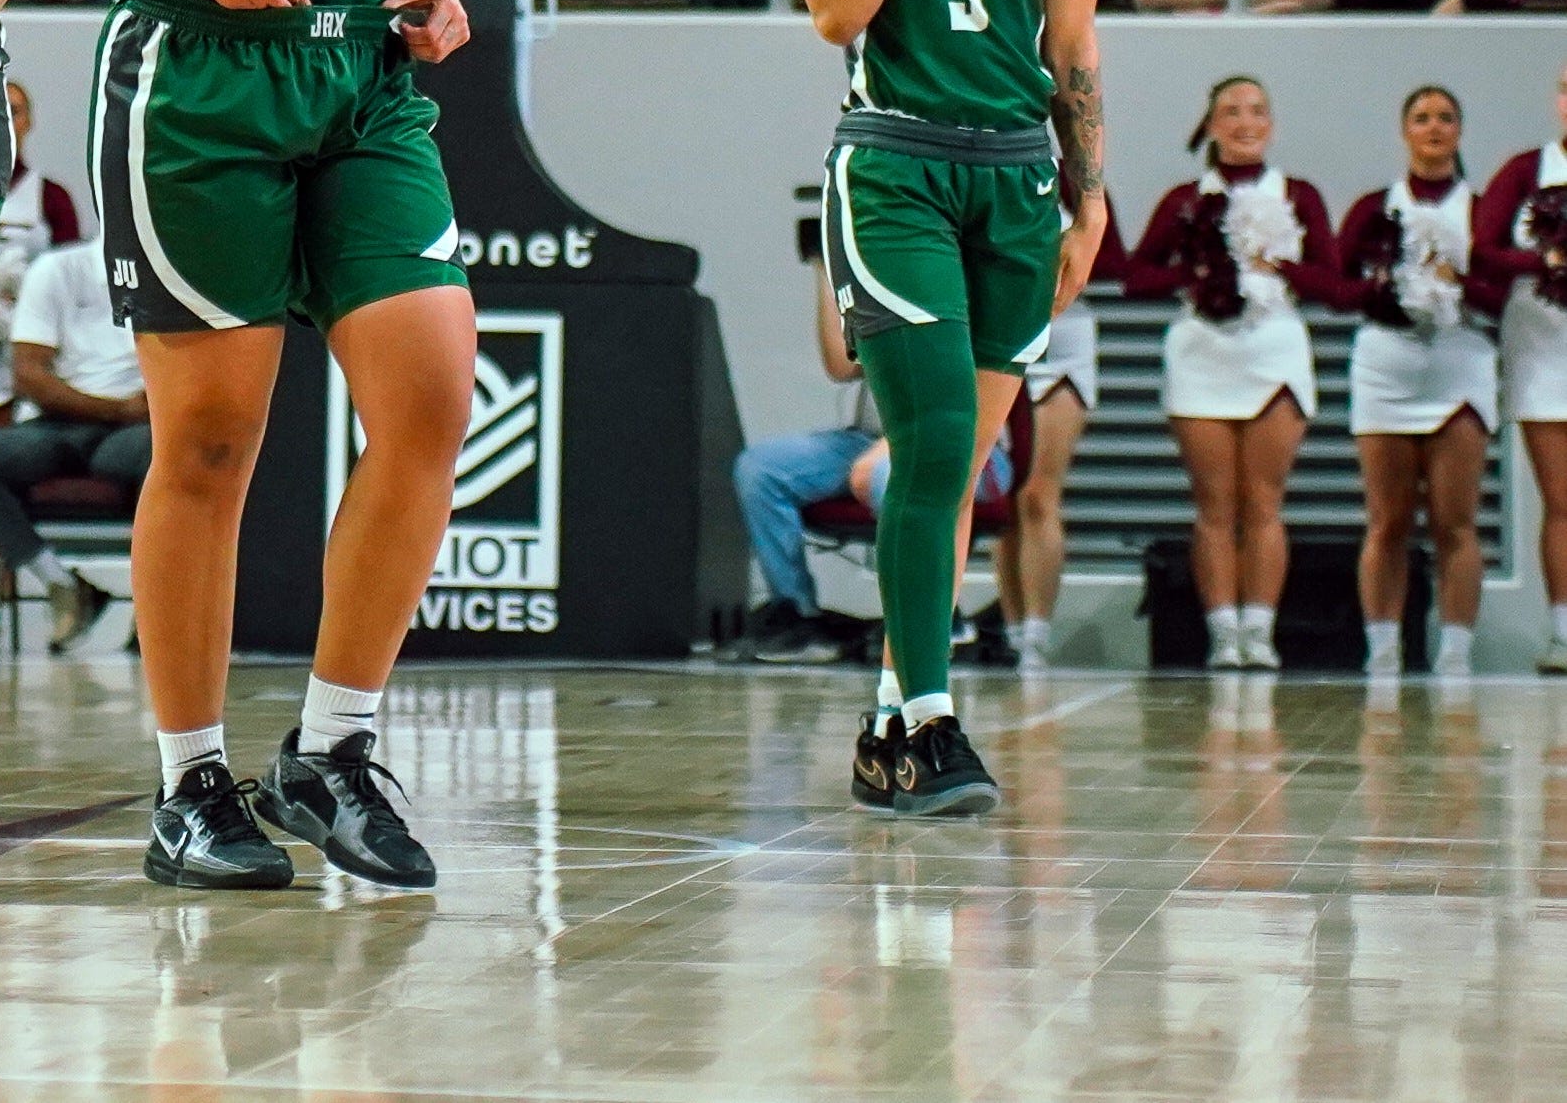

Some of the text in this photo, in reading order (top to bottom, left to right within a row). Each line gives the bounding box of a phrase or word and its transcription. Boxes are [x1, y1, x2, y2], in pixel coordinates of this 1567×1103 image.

[310, 11, 347, 38] JAX
[113, 257, 139, 289] JU
[433, 535, 540, 579] IOT
[409, 589, 559, 633] VICES
